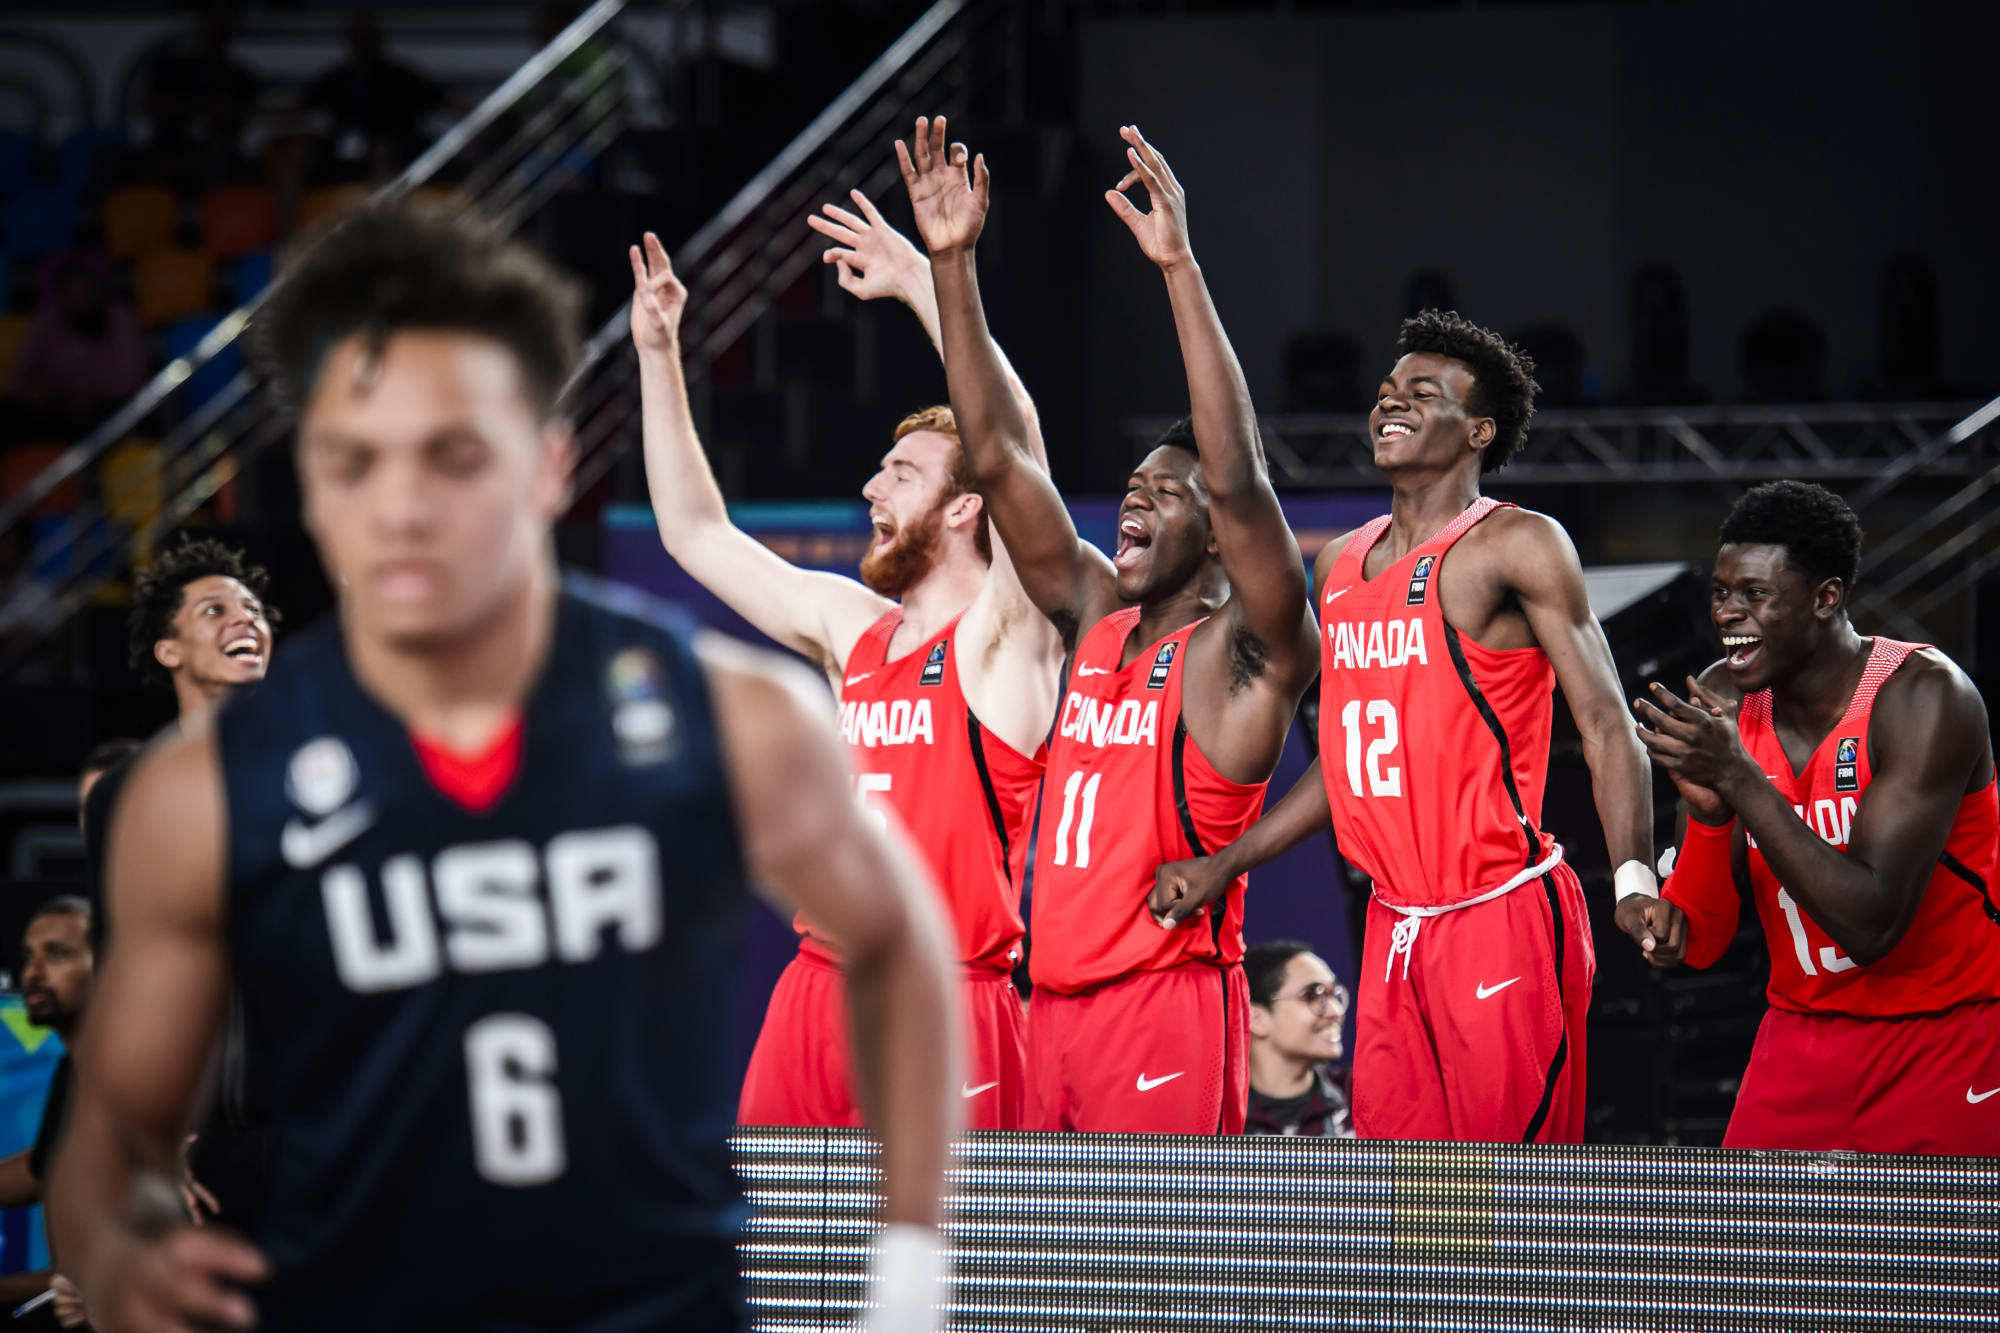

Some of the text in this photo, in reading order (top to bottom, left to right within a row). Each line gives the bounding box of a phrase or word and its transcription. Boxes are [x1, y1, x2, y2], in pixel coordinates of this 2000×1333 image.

[1060, 691, 1158, 748] CANADA
[1341, 699, 1402, 798] 12
[1053, 770, 1102, 868] 11
[321, 823, 664, 994] USA
[464, 1012, 567, 1187] 6
